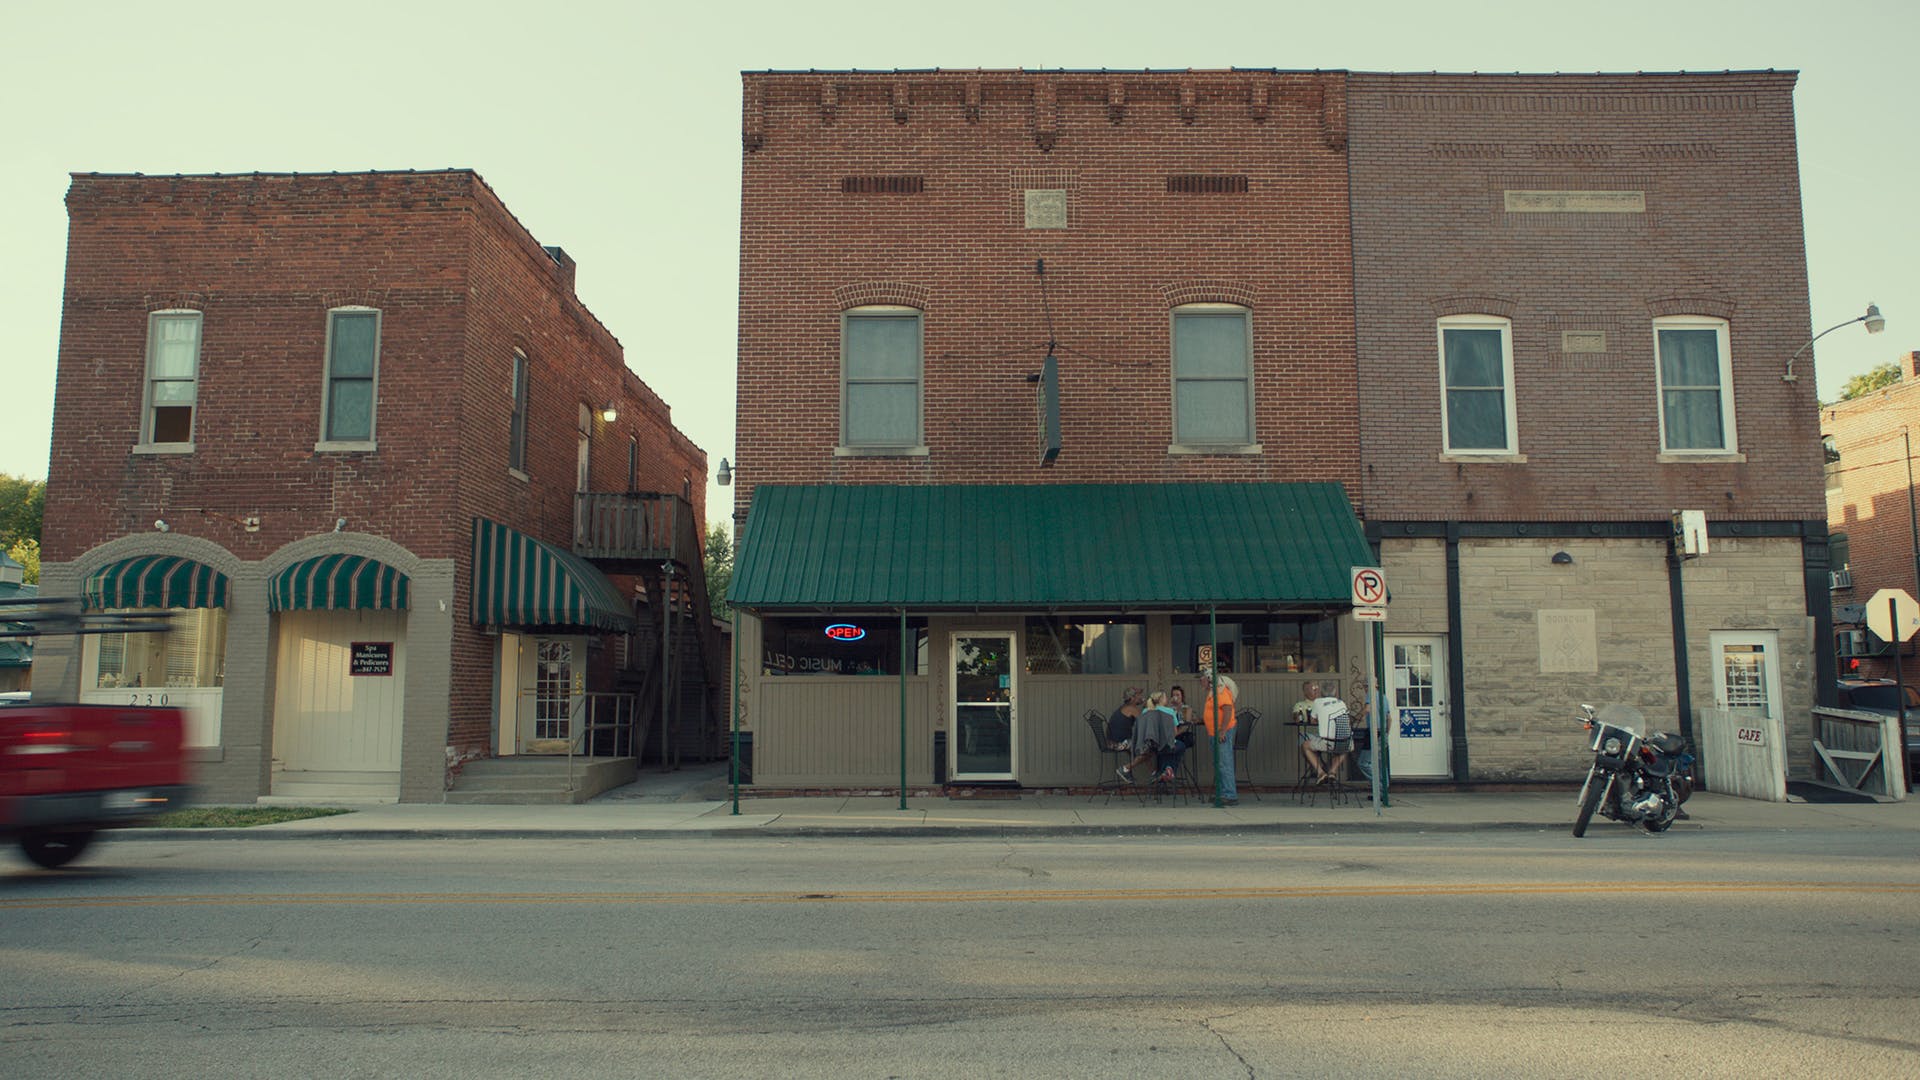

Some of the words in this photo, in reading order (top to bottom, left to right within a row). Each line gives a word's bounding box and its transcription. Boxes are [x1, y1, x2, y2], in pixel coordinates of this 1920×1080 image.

[827, 627, 862, 639] OPEN
[129, 694, 169, 707] 230
[1738, 728, 1762, 742] CAFE
